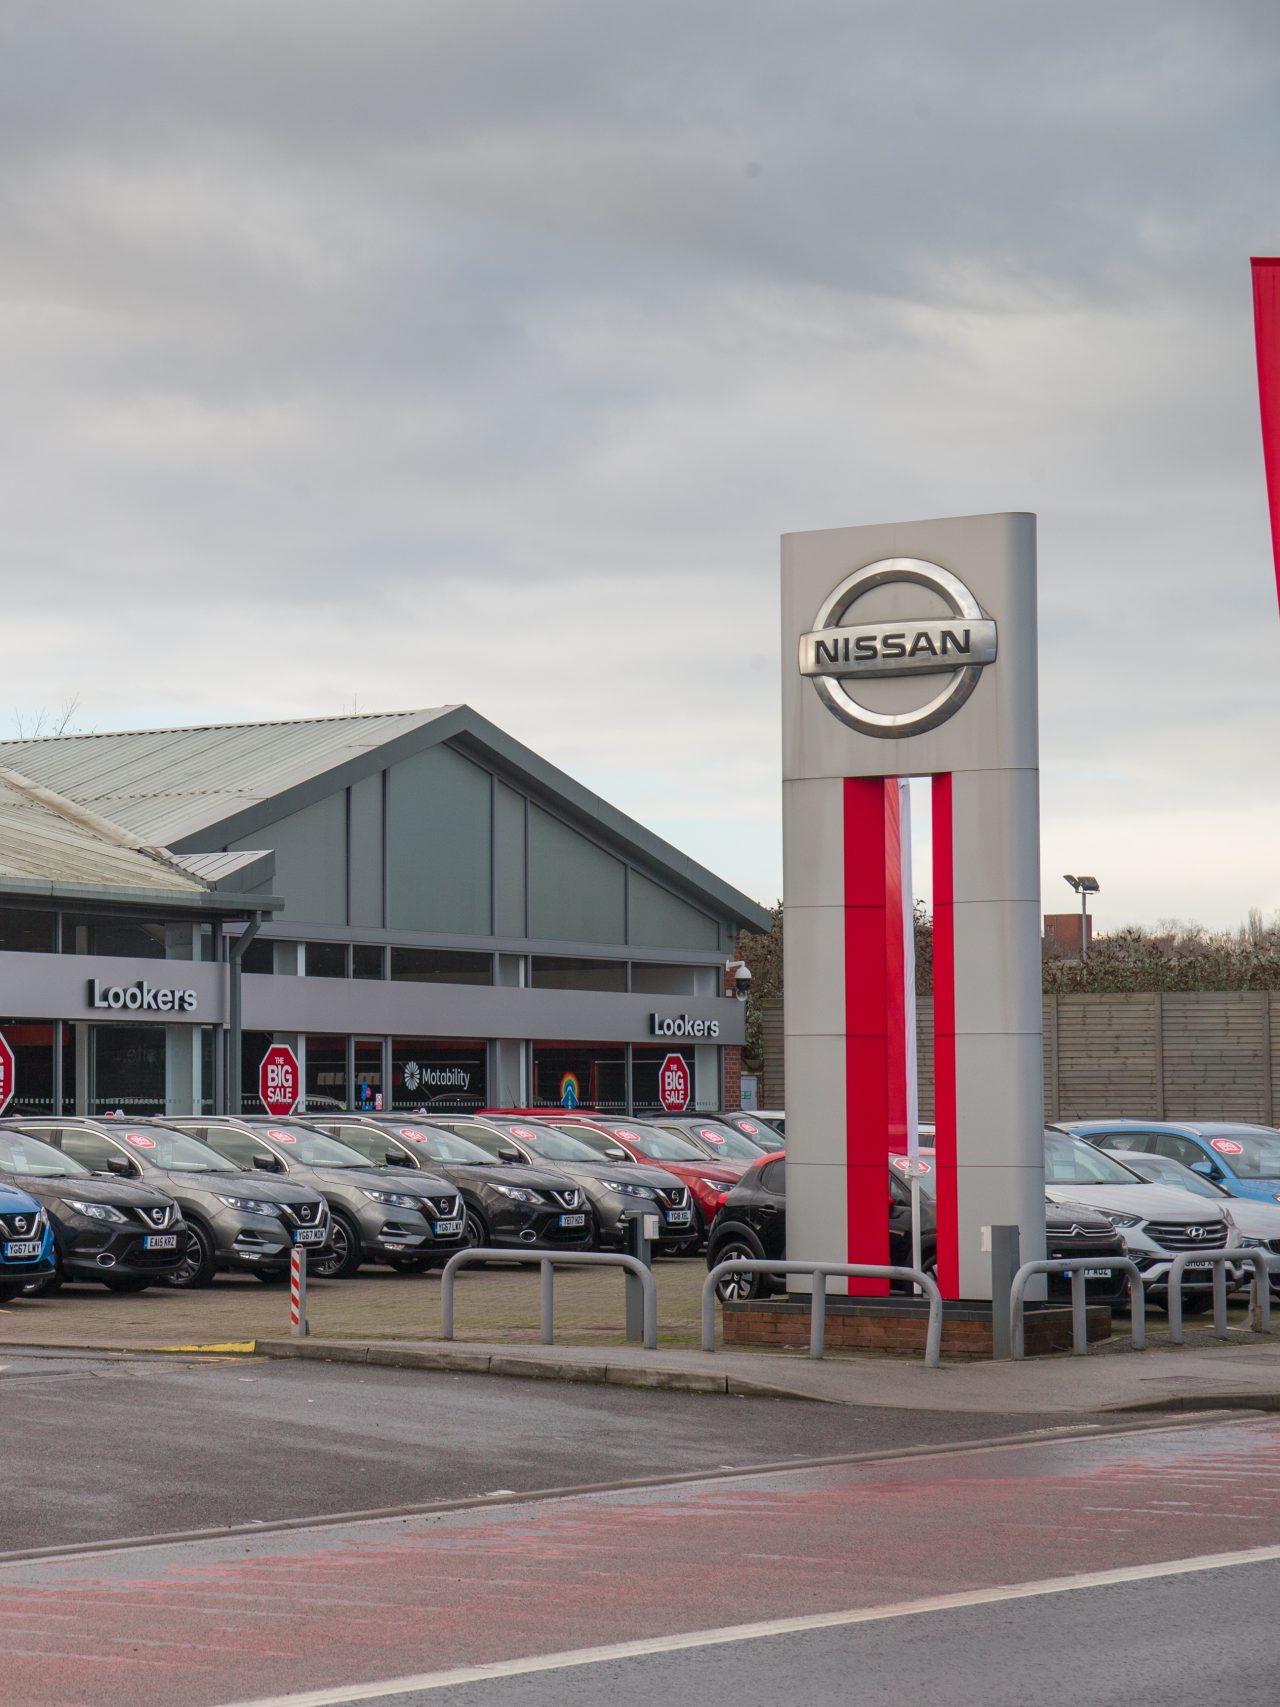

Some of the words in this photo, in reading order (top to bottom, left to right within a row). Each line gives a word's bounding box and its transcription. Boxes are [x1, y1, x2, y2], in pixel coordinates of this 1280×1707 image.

[815, 629, 971, 664] NISSAN
[91, 979, 198, 1011] Lookers
[653, 1013, 720, 1037] Lookers
[267, 1064, 293, 1087] BIG
[422, 1068, 470, 1090] Motability
[665, 1071, 684, 1090] BIG
[267, 1087, 293, 1103] SALE
[665, 1091, 684, 1104] SALE
[10, 1244, 27, 1254] YG67
